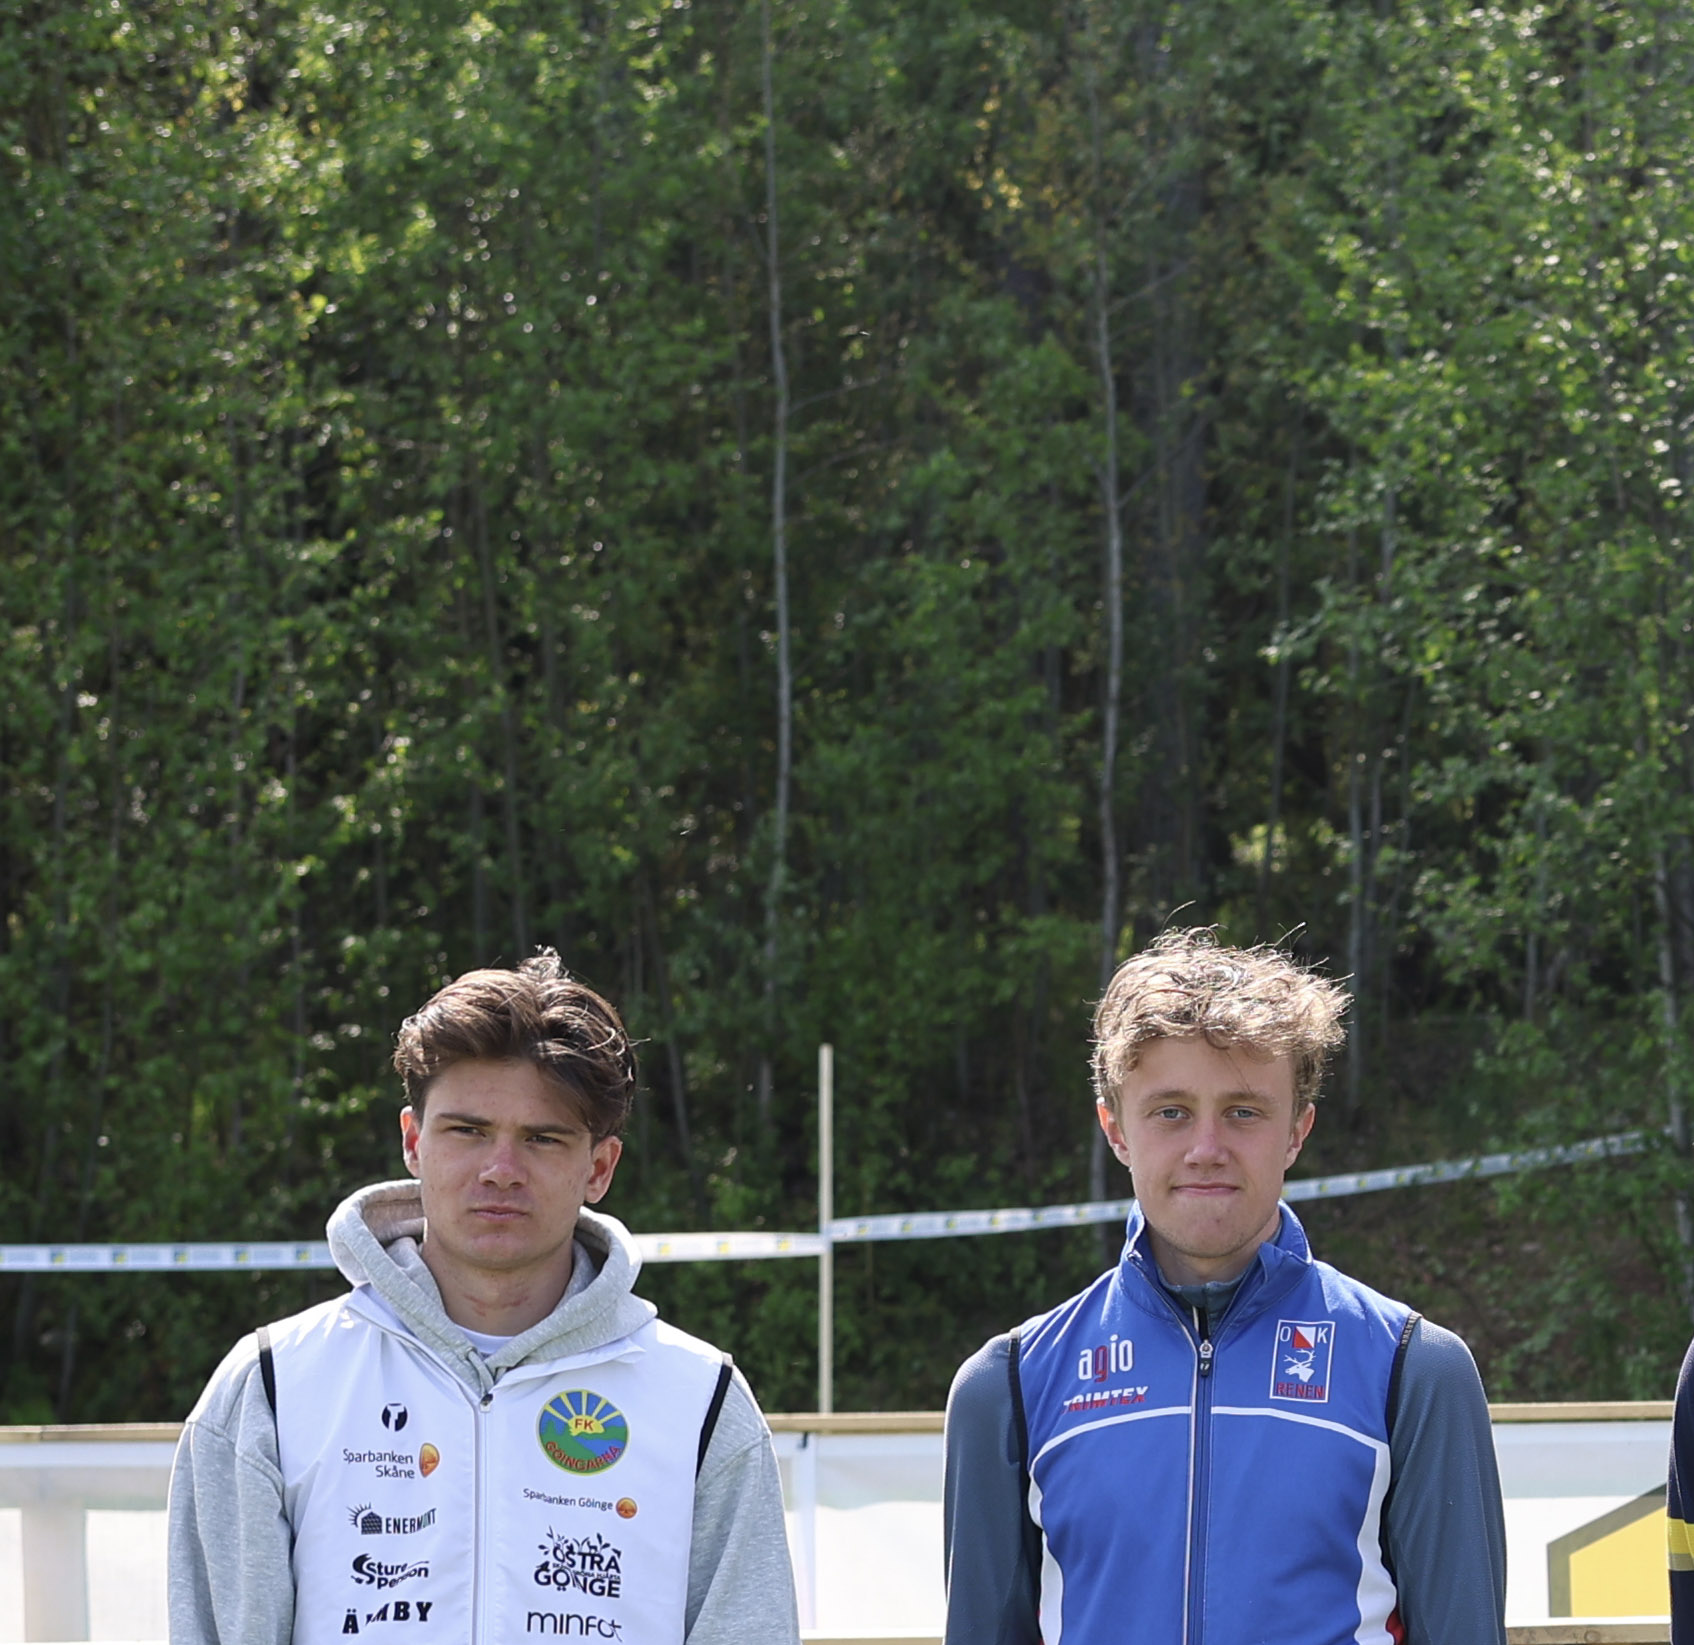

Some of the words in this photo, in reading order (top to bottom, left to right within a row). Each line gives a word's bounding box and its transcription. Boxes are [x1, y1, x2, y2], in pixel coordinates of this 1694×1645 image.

[1078, 1334, 1133, 1383] agio
[1276, 1382, 1324, 1399] RENEN
[1062, 1386, 1148, 1415] TRIMTEX
[574, 1418, 594, 1431] FK
[343, 1448, 414, 1465] Sparbanken
[375, 1464, 415, 1479] Skåne
[578, 1497, 614, 1512] Göinge
